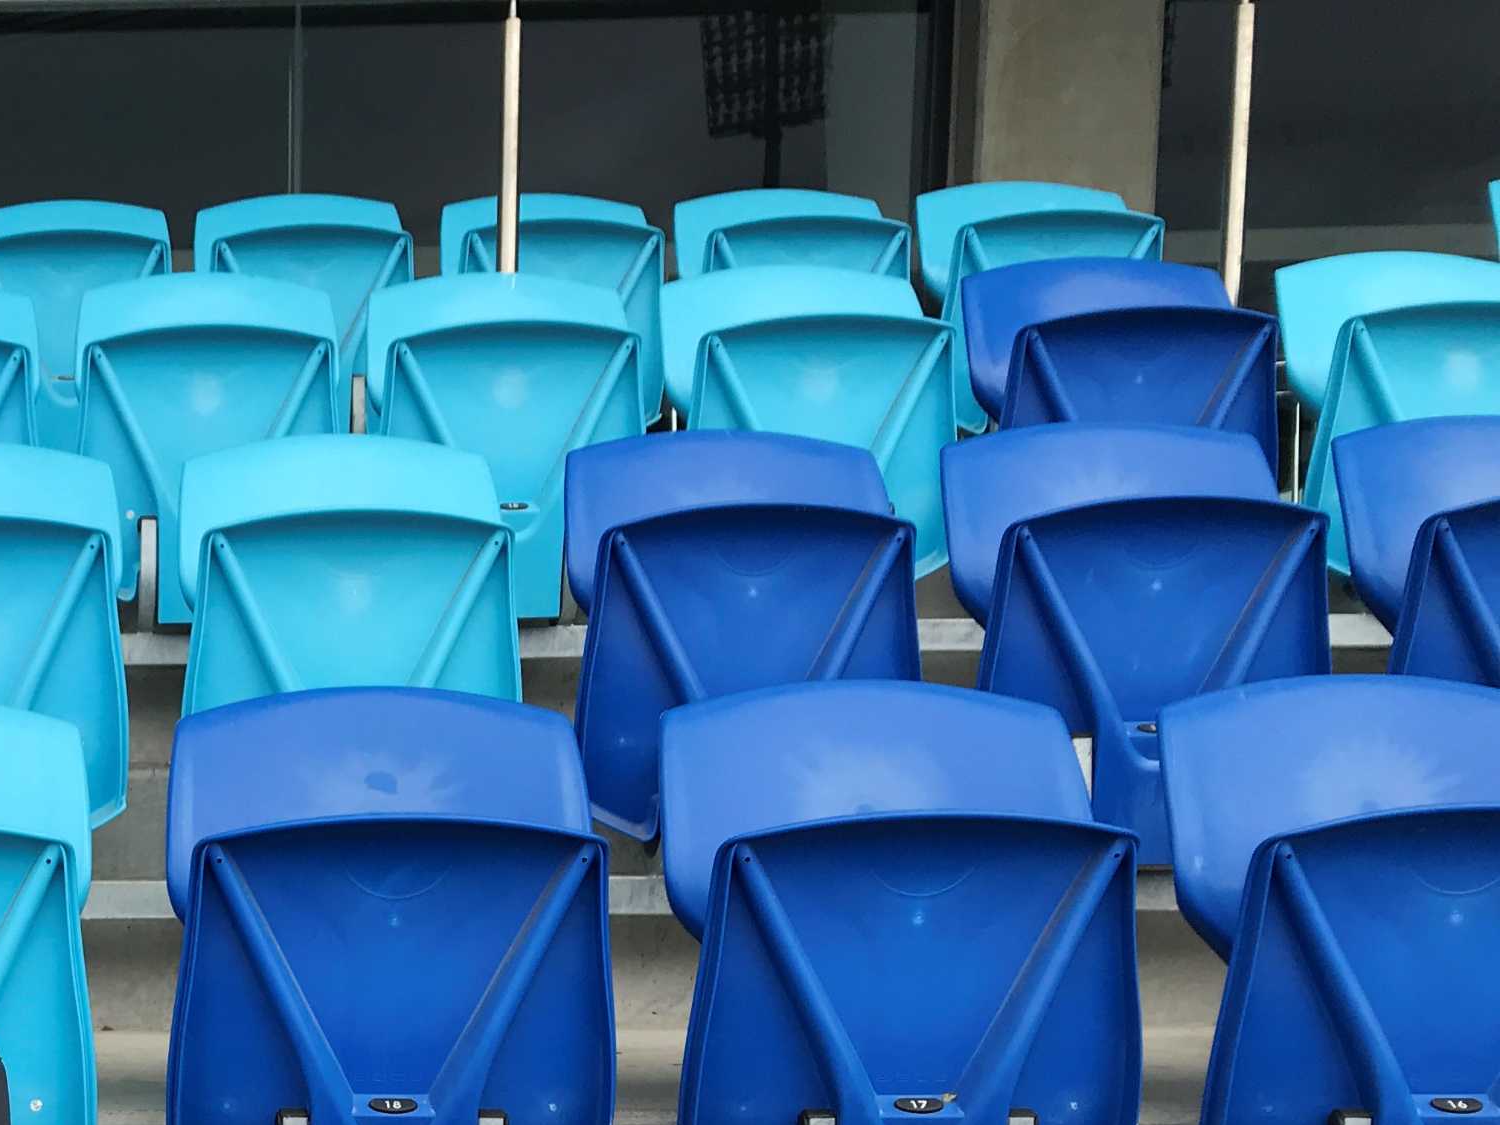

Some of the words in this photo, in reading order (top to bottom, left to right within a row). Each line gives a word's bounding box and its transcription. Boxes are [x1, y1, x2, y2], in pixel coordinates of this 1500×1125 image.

[385, 1100, 402, 1109] 18
[910, 1100, 927, 1109] 17
[1447, 1100, 1468, 1109] 16
